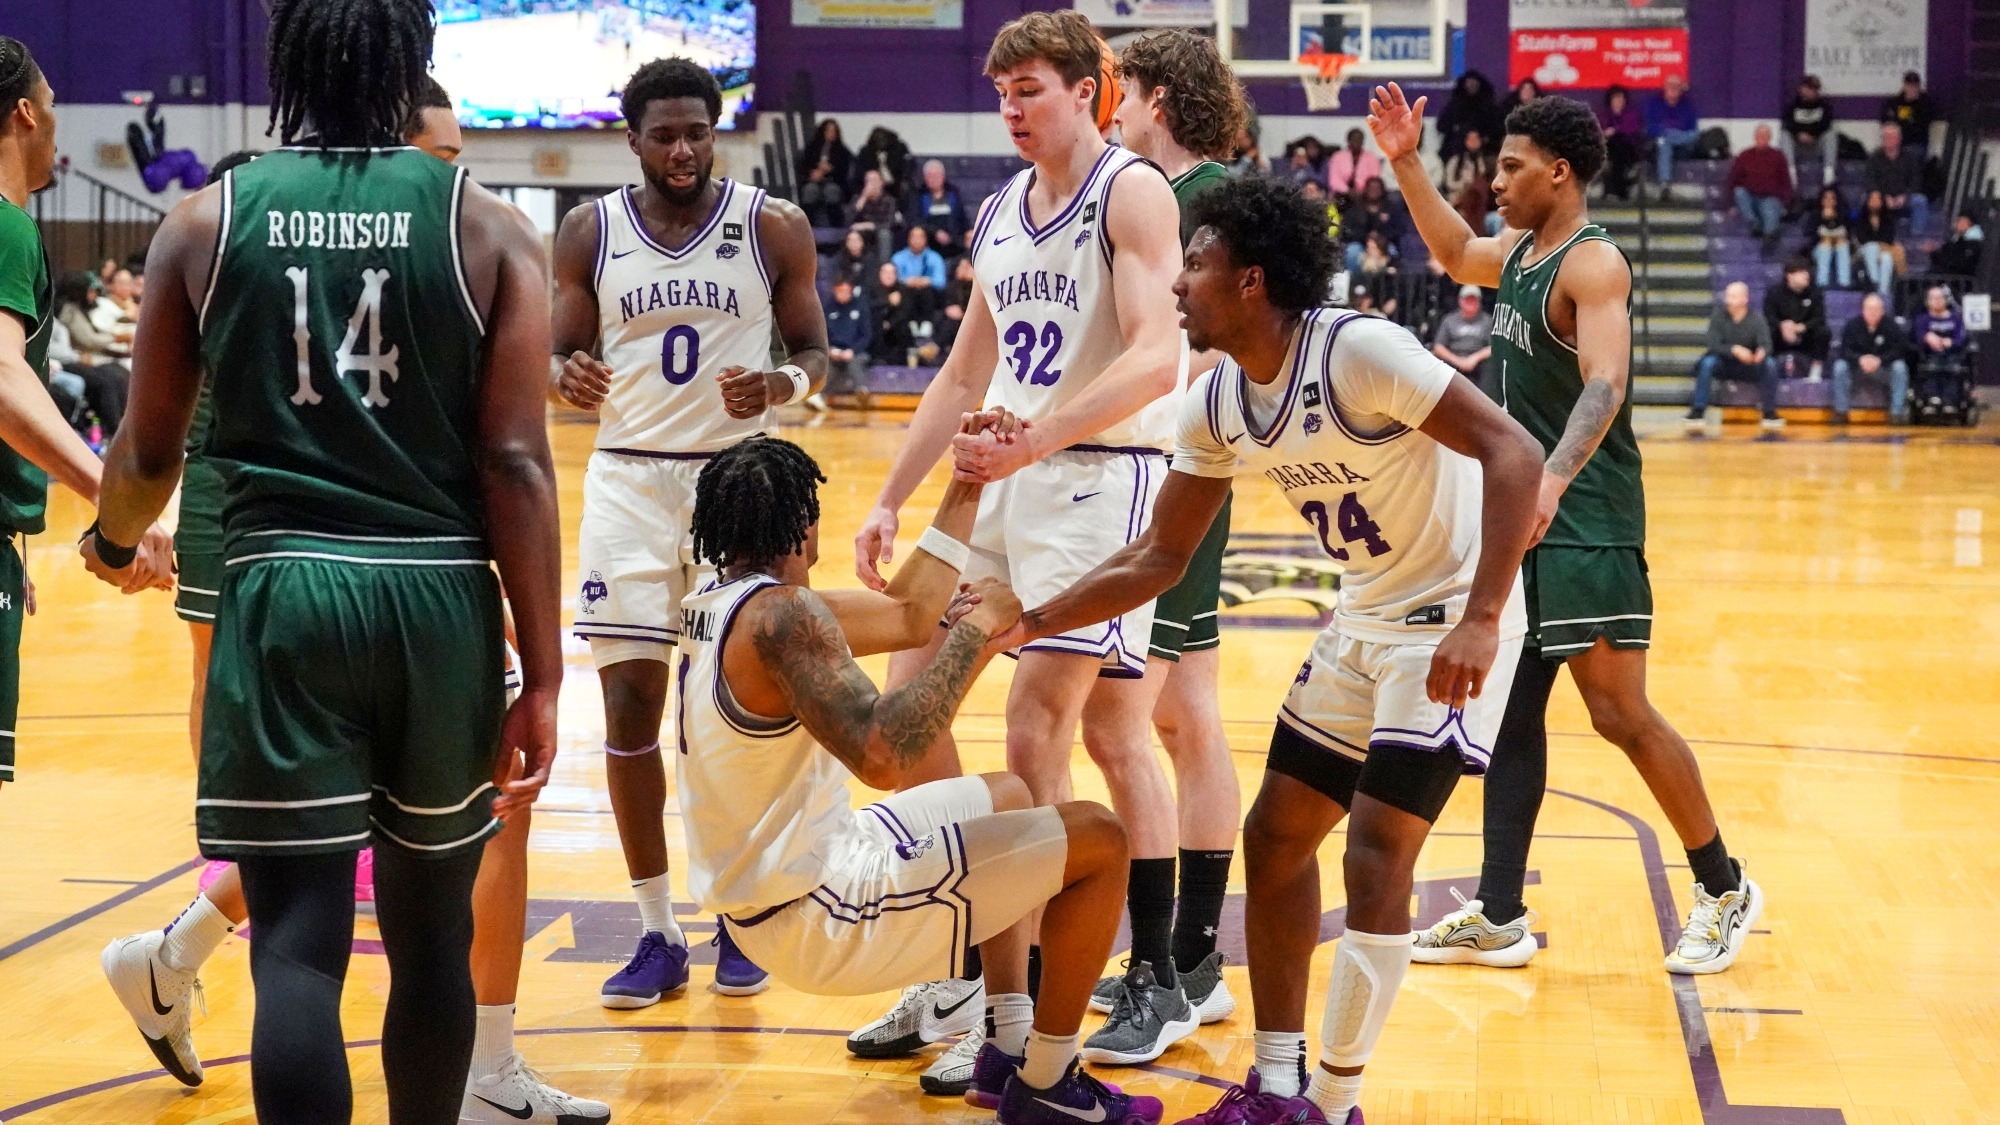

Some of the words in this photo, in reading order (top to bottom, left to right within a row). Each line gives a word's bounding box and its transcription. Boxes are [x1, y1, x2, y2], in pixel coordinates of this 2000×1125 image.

[1623, 66, 1661, 79] Agent
[267, 211, 412, 249] ROBINSON
[619, 279, 741, 324] NIAGARA
[994, 270, 1079, 313] NIAGARA
[285, 266, 399, 408] 14
[661, 324, 700, 385] 0
[1004, 320, 1063, 386] 32
[1264, 462, 1370, 492] IAGARA
[1301, 492, 1392, 561] 24
[1431, 610, 1440, 618] M
[678, 653, 691, 756] 1
